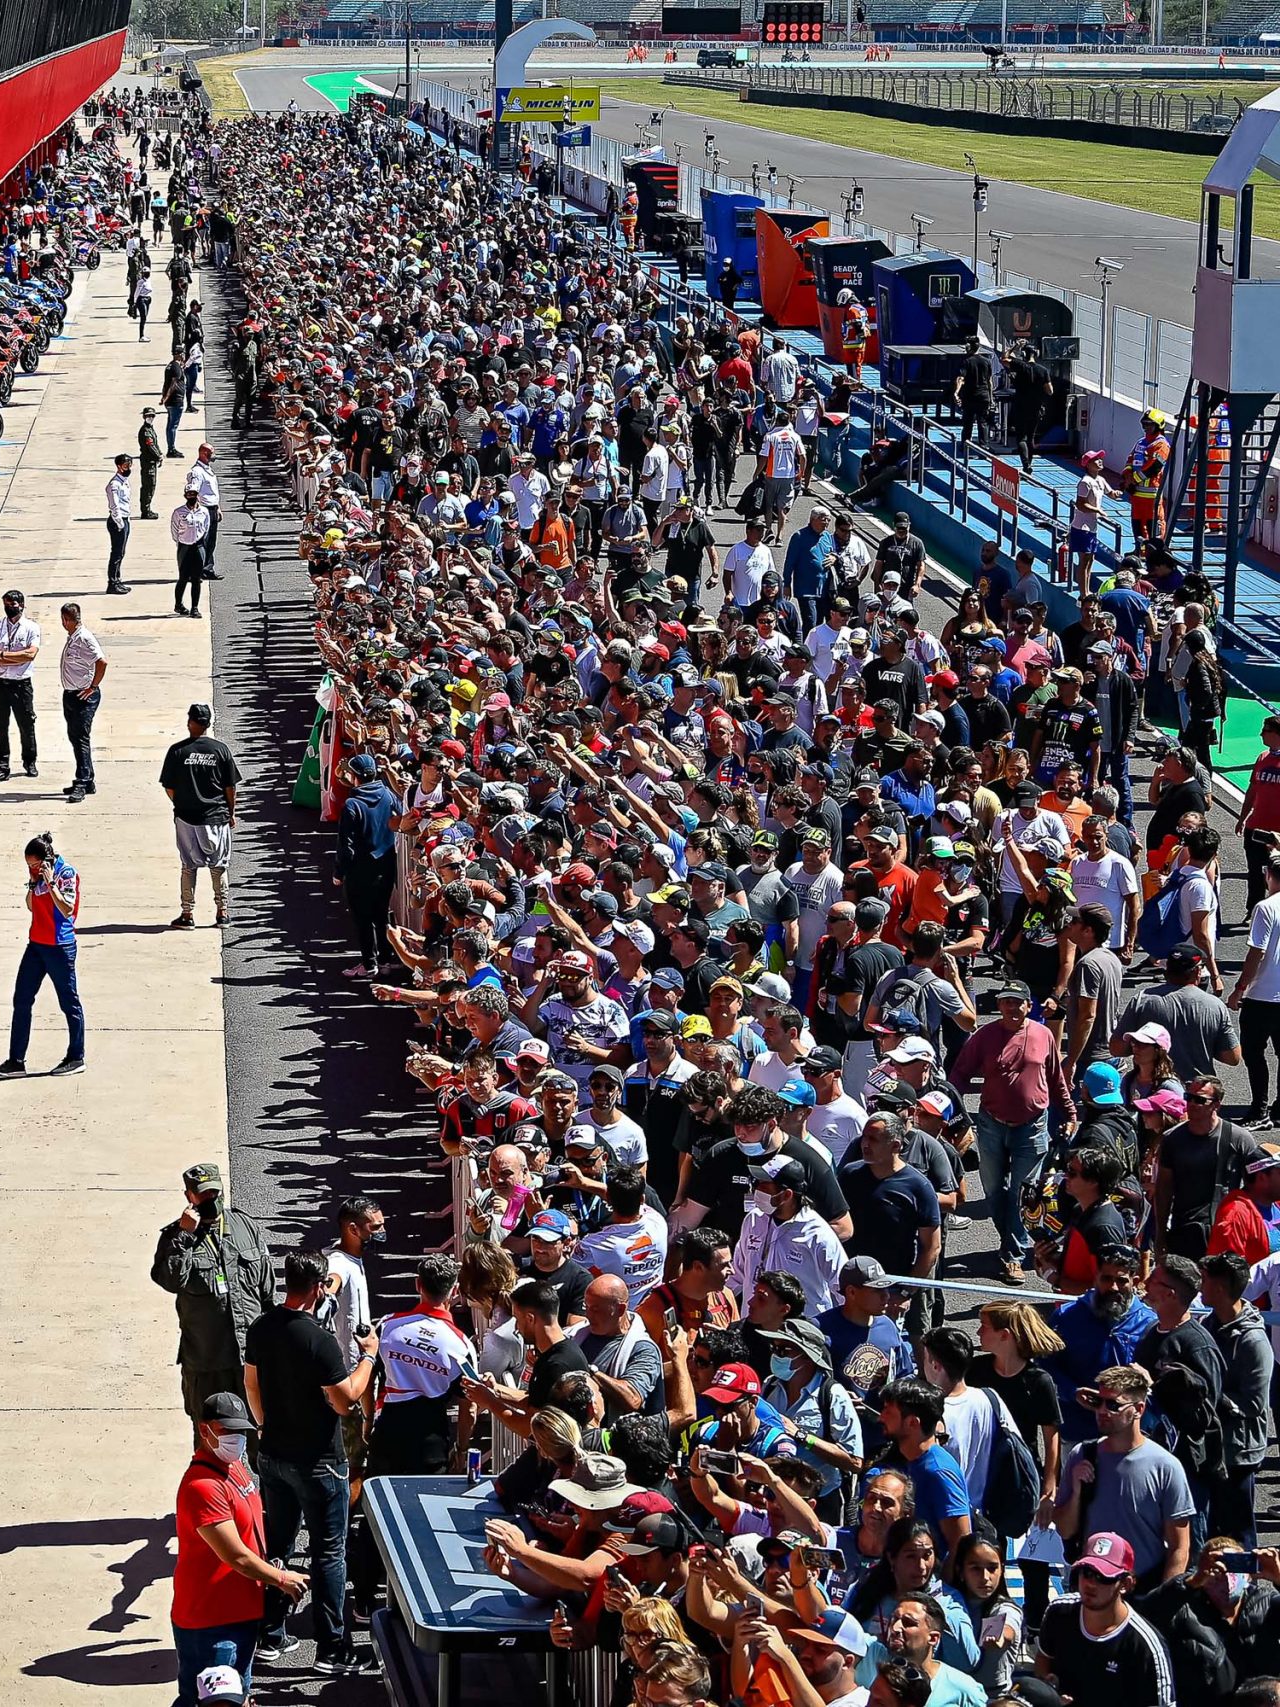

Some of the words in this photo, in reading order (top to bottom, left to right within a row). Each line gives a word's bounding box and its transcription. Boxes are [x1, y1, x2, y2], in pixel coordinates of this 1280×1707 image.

[526, 100, 594, 109] MICHLIN
[842, 278, 863, 286] RACE
[878, 670, 905, 684] VANS
[189, 752, 215, 760] STAFF
[184, 758, 217, 766] CONTROL
[806, 828, 825, 841] 46
[661, 1088, 677, 1099] sky
[624, 1254, 663, 1275] REPSOL
[387, 1350, 450, 1377] HONDA
[498, 1638, 517, 1646] 73
